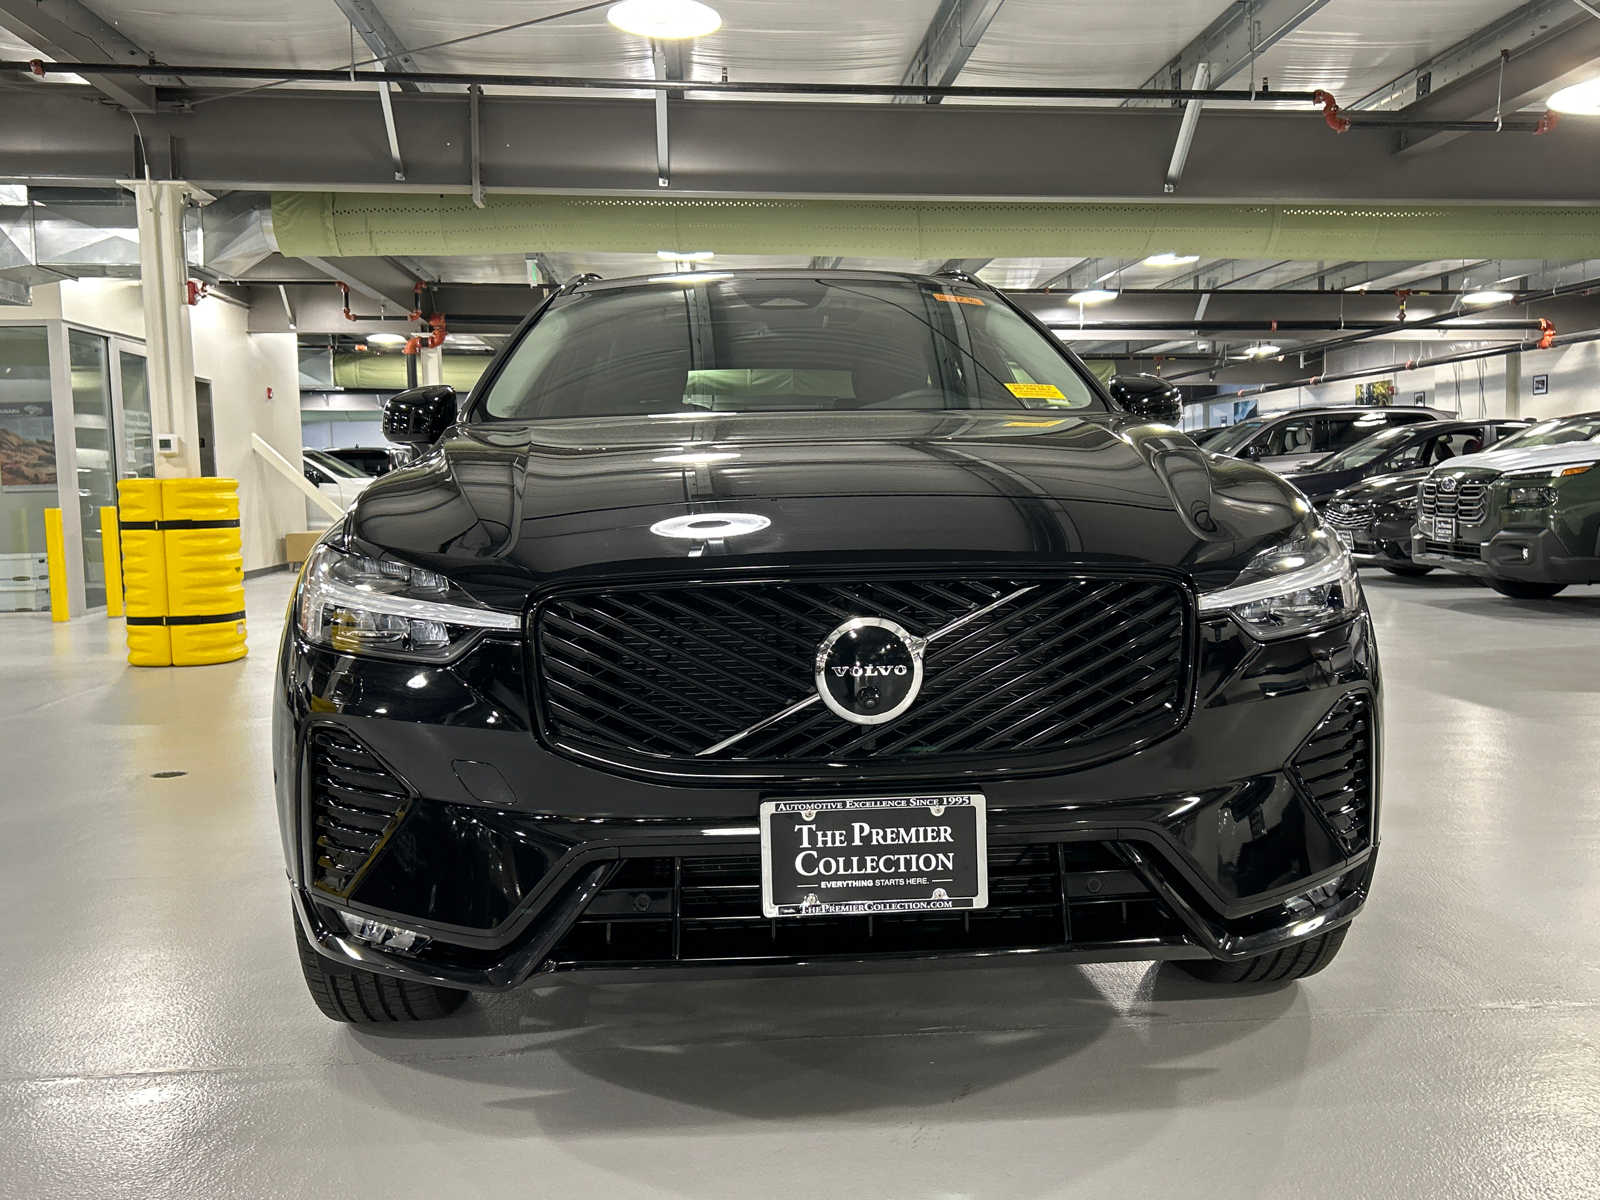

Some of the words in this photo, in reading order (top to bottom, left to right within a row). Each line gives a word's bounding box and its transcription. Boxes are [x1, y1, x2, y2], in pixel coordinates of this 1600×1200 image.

[831, 664, 908, 677] VOLVO
[942, 796, 970, 805] 1995
[821, 879, 874, 889] EVERYTHING
[874, 878, 905, 887] STARTS
[906, 877, 929, 886] HERE.
